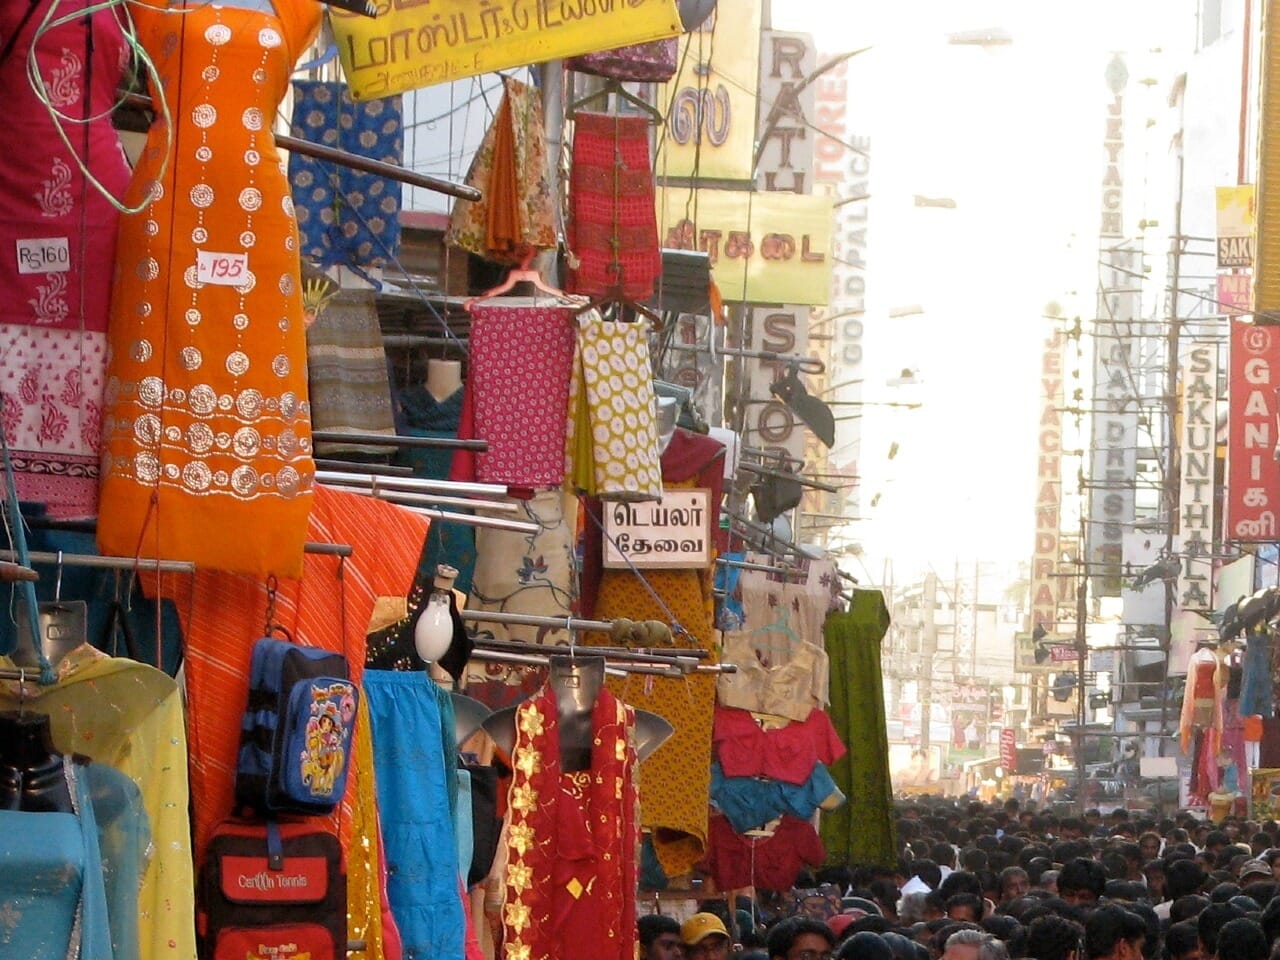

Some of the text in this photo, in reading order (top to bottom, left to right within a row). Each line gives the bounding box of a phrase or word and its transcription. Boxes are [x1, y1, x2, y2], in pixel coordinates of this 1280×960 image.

[211, 258, 245, 279] 195
[1181, 348, 1213, 607] SAKUNTHALA
[1243, 358, 1271, 482] GANI
